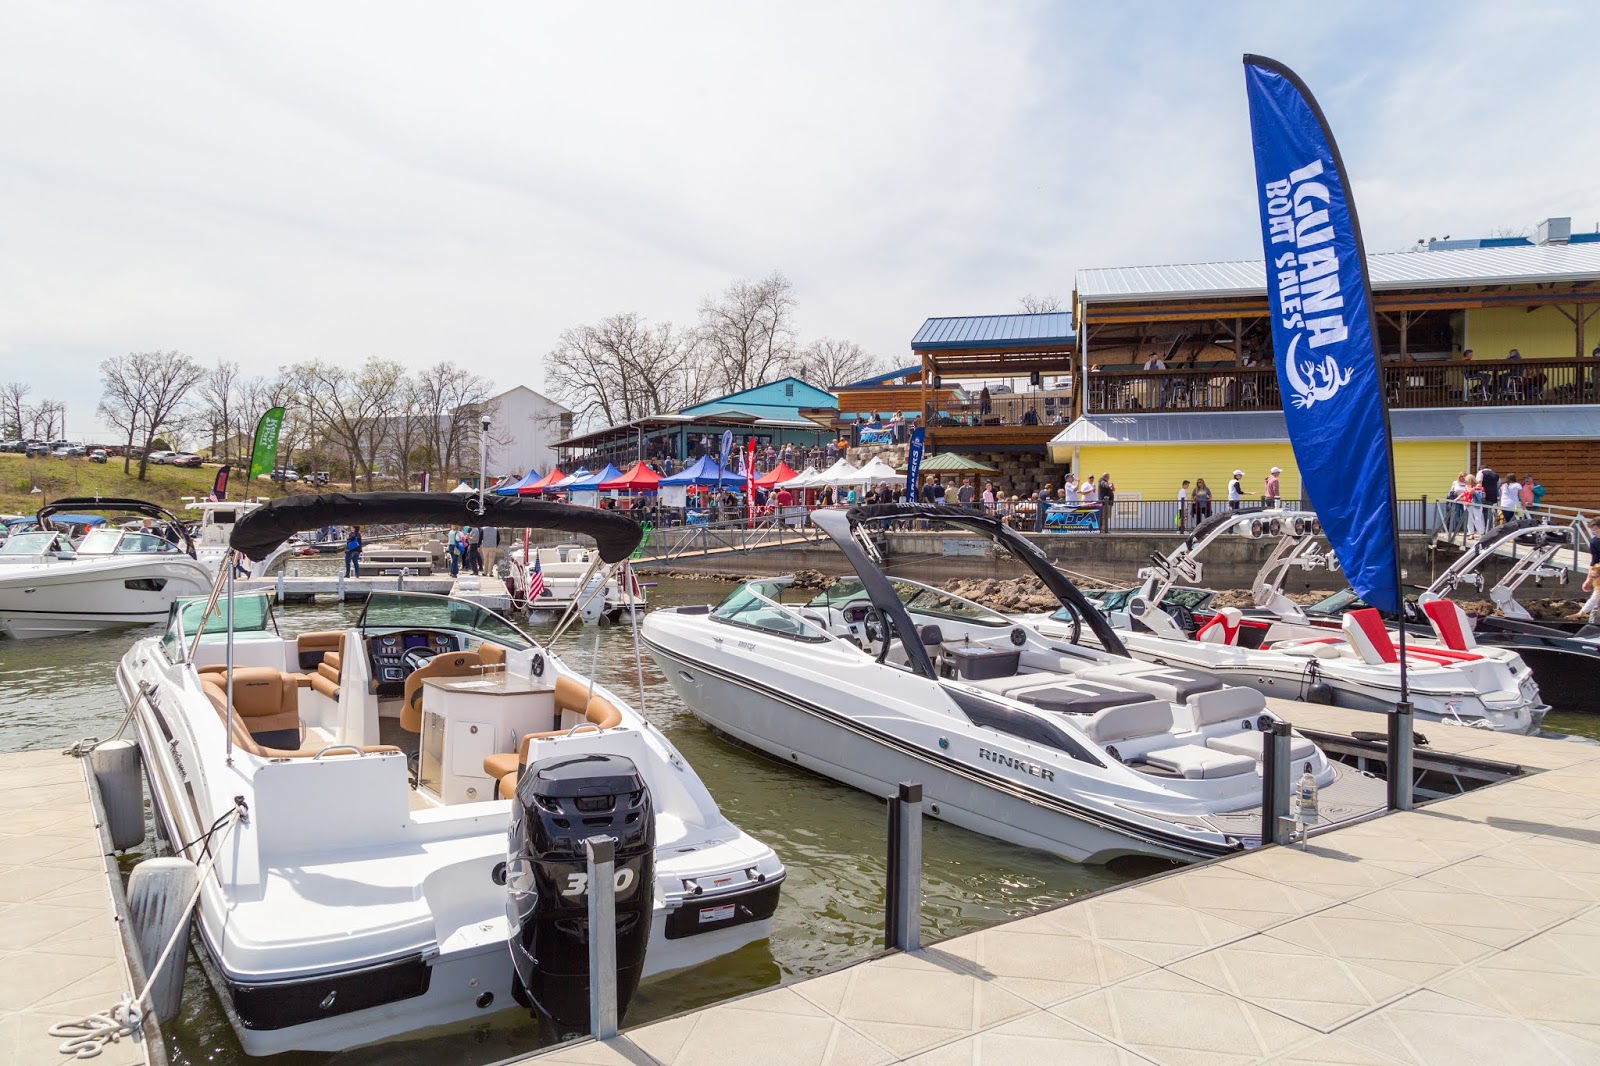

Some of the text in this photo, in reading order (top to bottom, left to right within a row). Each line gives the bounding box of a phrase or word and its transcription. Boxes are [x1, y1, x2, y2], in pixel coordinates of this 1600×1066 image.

[1265, 179, 1305, 330] BOAT SALES
[1289, 159, 1349, 349] IGUANA
[979, 747, 1055, 782] RINKER
[561, 867, 634, 896] 30
